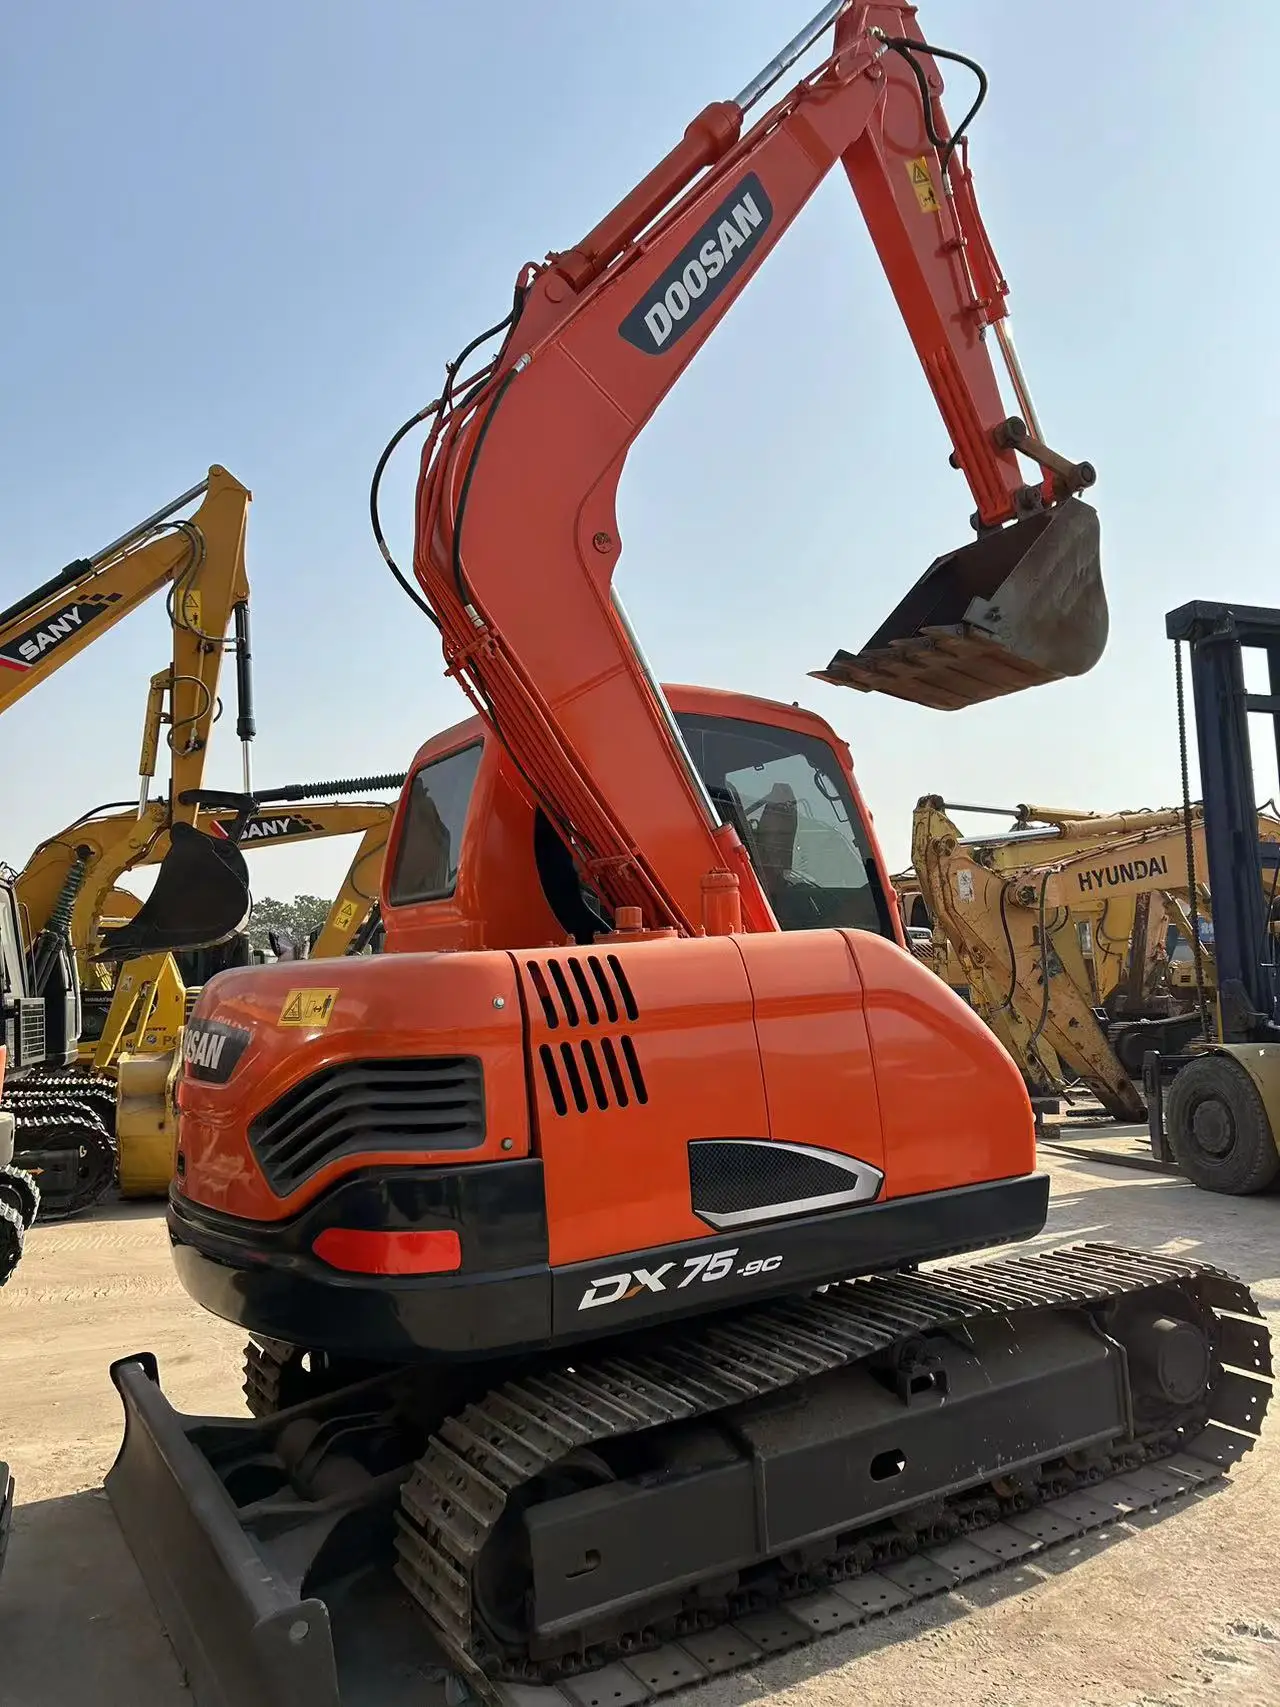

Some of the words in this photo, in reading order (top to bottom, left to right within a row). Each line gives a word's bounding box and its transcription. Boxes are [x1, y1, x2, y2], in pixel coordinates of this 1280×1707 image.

[643, 191, 763, 347] DOOSAN
[18, 605, 83, 661] SANY
[1077, 855, 1168, 892] HYUNDAI
